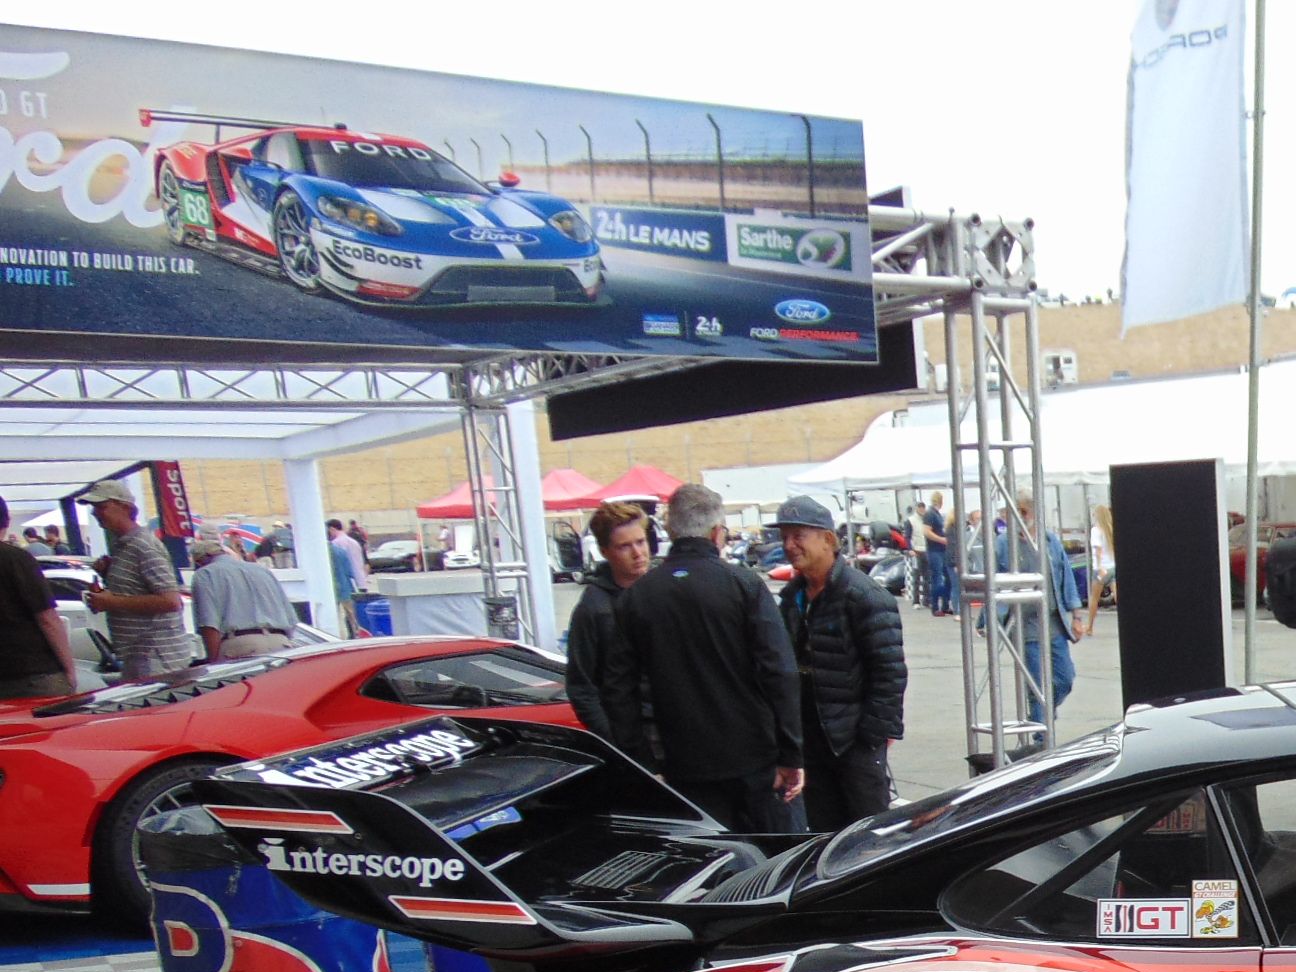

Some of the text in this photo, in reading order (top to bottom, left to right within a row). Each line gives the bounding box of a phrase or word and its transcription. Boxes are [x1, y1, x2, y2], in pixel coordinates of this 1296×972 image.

[20, 92, 48, 118] GT
[329, 140, 432, 161] FORD
[184, 193, 208, 225] 68
[469, 226, 523, 244] Ford
[629, 225, 651, 243] LE
[653, 227, 711, 251] MANS
[740, 227, 793, 250] Sarthe
[72, 252, 89, 268] TO
[93, 253, 133, 271] BUILD
[137, 255, 166, 273] THIS
[170, 257, 200, 274] CAR.
[332, 239, 422, 270] EcoBoost
[6, 267, 50, 285] PROVE
[785, 303, 819, 320] Ford
[750, 328, 778, 338] FORD
[1194, 881, 1236, 891] CAMEL
[1136, 906, 1185, 930] GT
